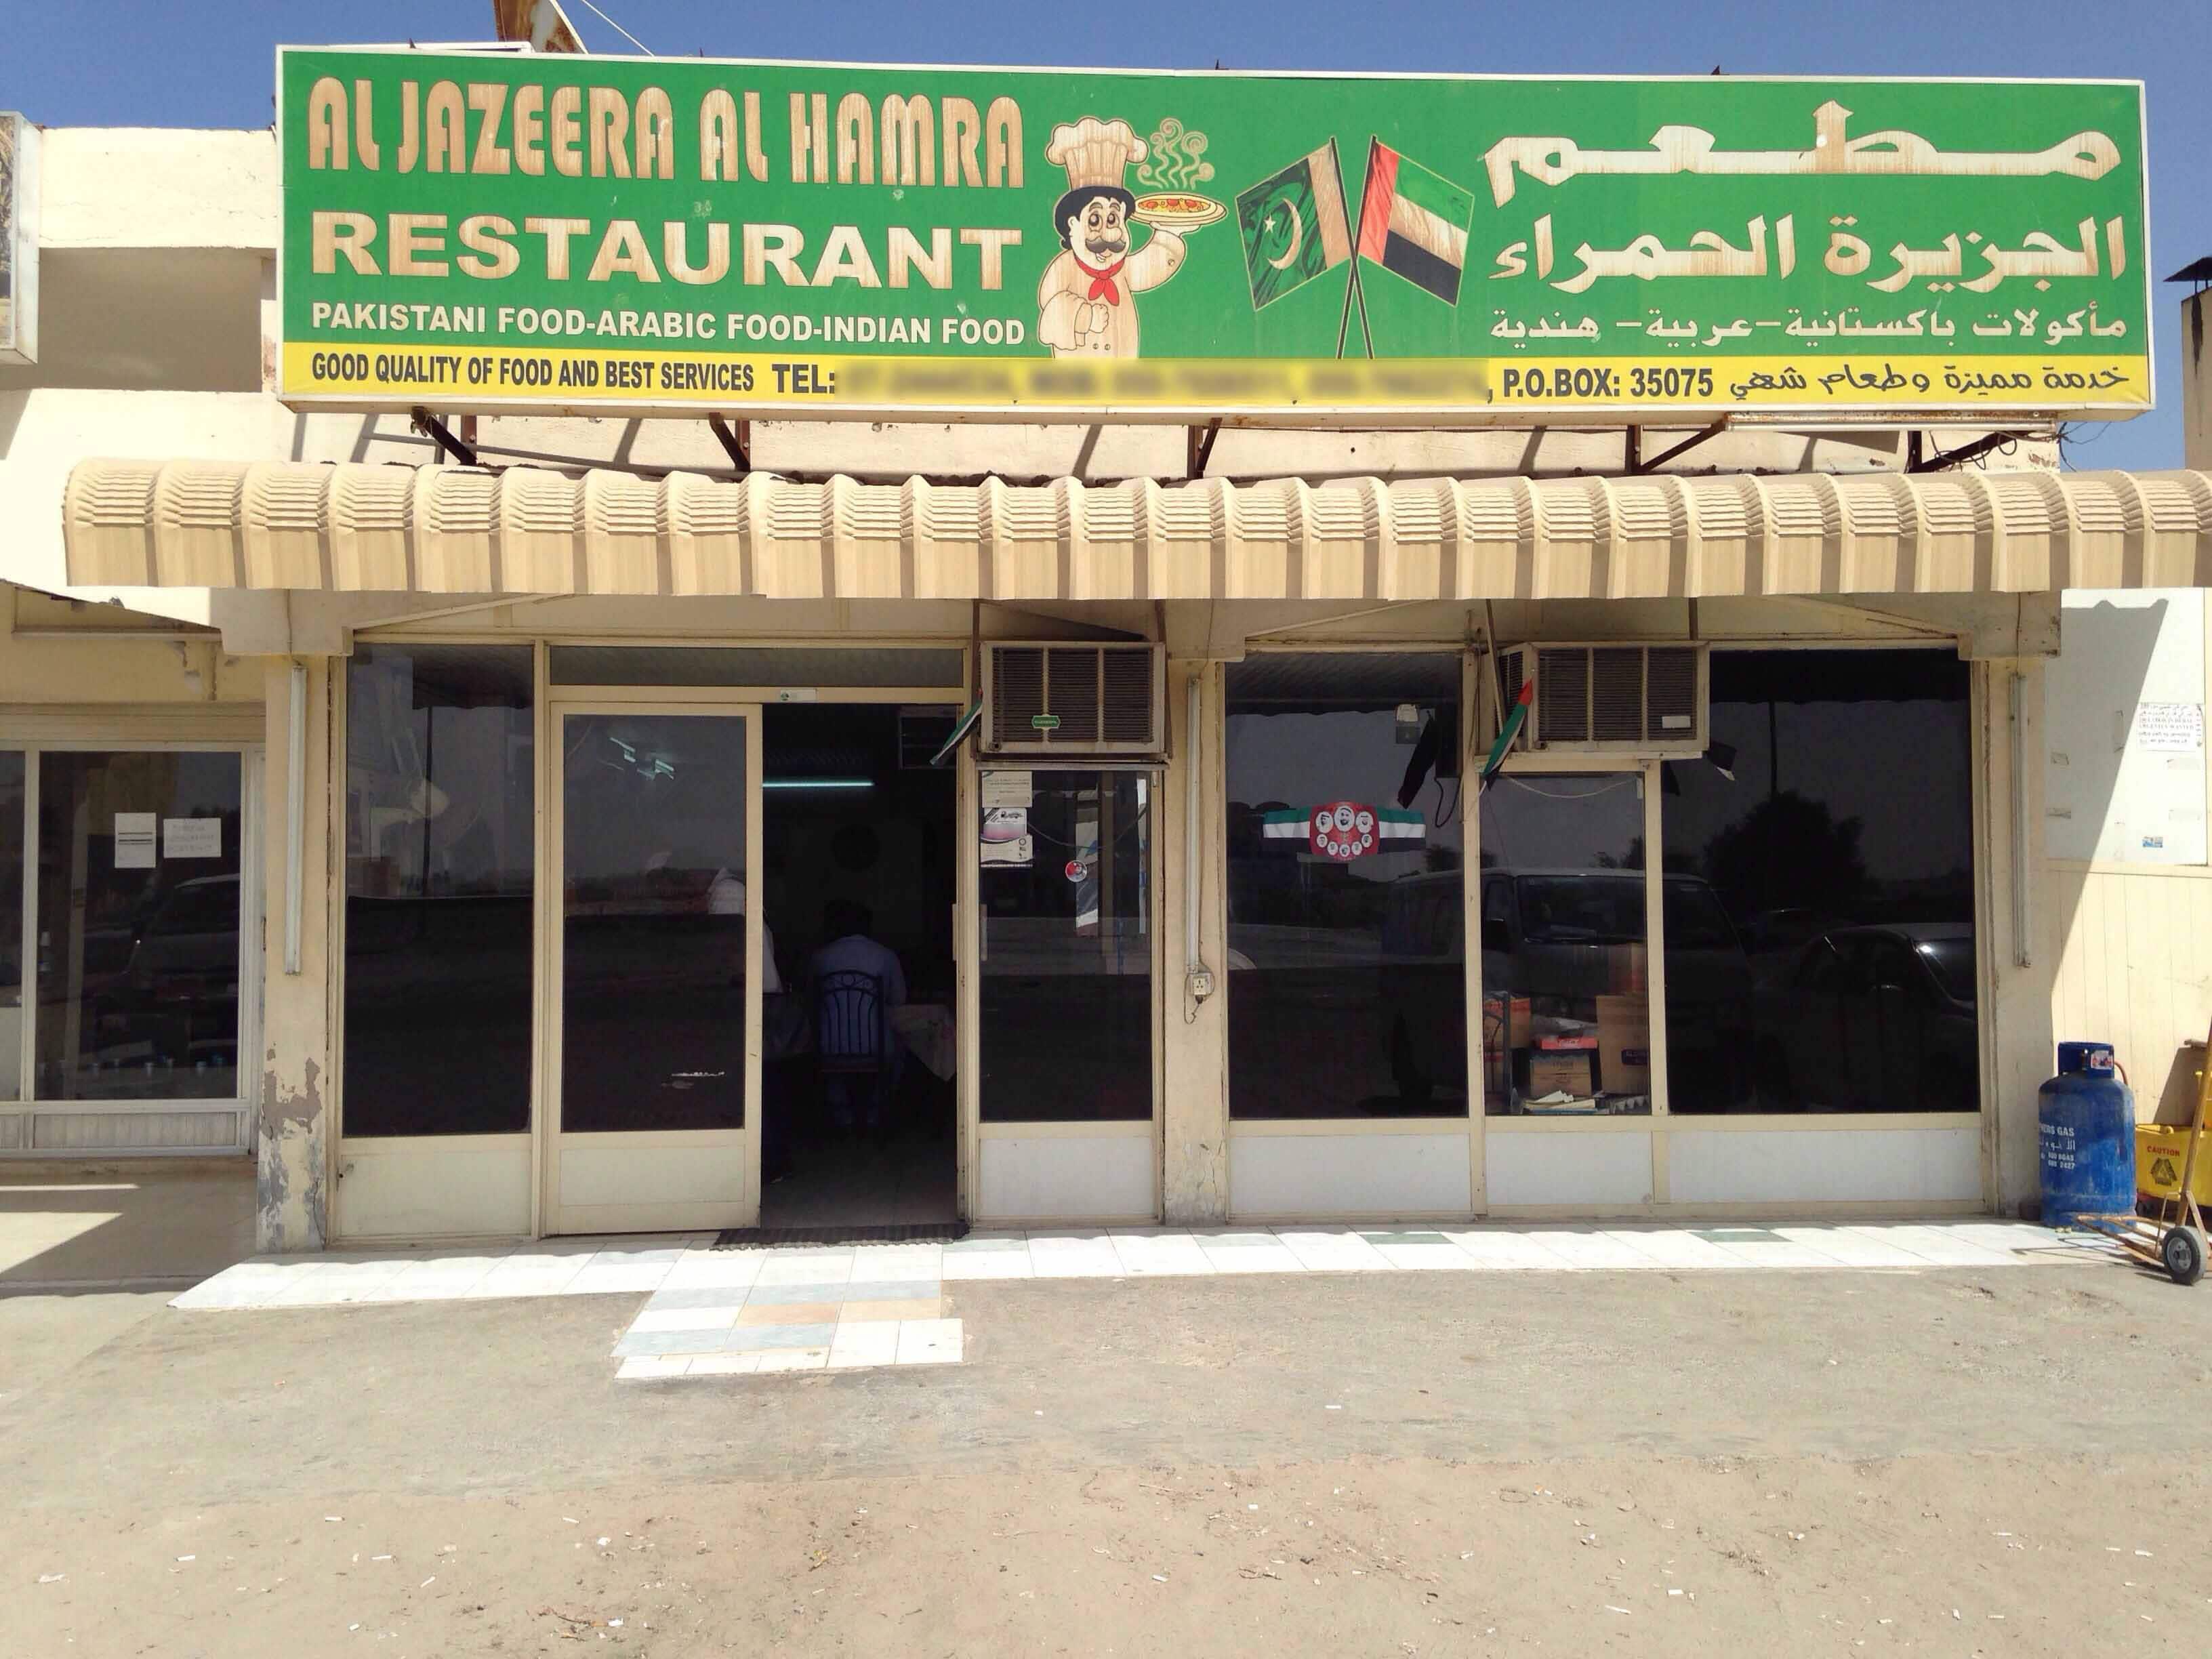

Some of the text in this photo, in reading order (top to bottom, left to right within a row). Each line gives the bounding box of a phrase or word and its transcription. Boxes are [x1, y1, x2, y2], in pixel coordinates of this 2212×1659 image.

[308, 77, 1024, 188] AL JAZEERA AL HAMRA
[1483, 100, 2121, 207] مطعم
[312, 211, 1022, 291] RESTAURANT
[1489, 213, 2127, 293] الجزيرة الحمراء
[312, 302, 485, 333] PAKISTANI
[942, 319, 1025, 345] FOOD
[1973, 300, 2127, 346] مأكولات
[312, 352, 369, 382] GOOD
[375, 354, 462, 384] QUALITY
[468, 357, 493, 385] OF
[499, 357, 553, 386] FOOD
[558, 360, 600, 387] AND
[605, 361, 655, 389] BEST
[661, 362, 755, 392] SERVICES
[771, 363, 835, 394] TEL:
[1503, 368, 1620, 398] P.O.BOX:
[1629, 368, 1714, 397] 35075
[1943, 364, 2032, 395] مميزة
[2042, 365, 2131, 390] خدمة
[2057, 1126, 2074, 1136] GAS
[2146, 1145, 2180, 1157] CAUTION
